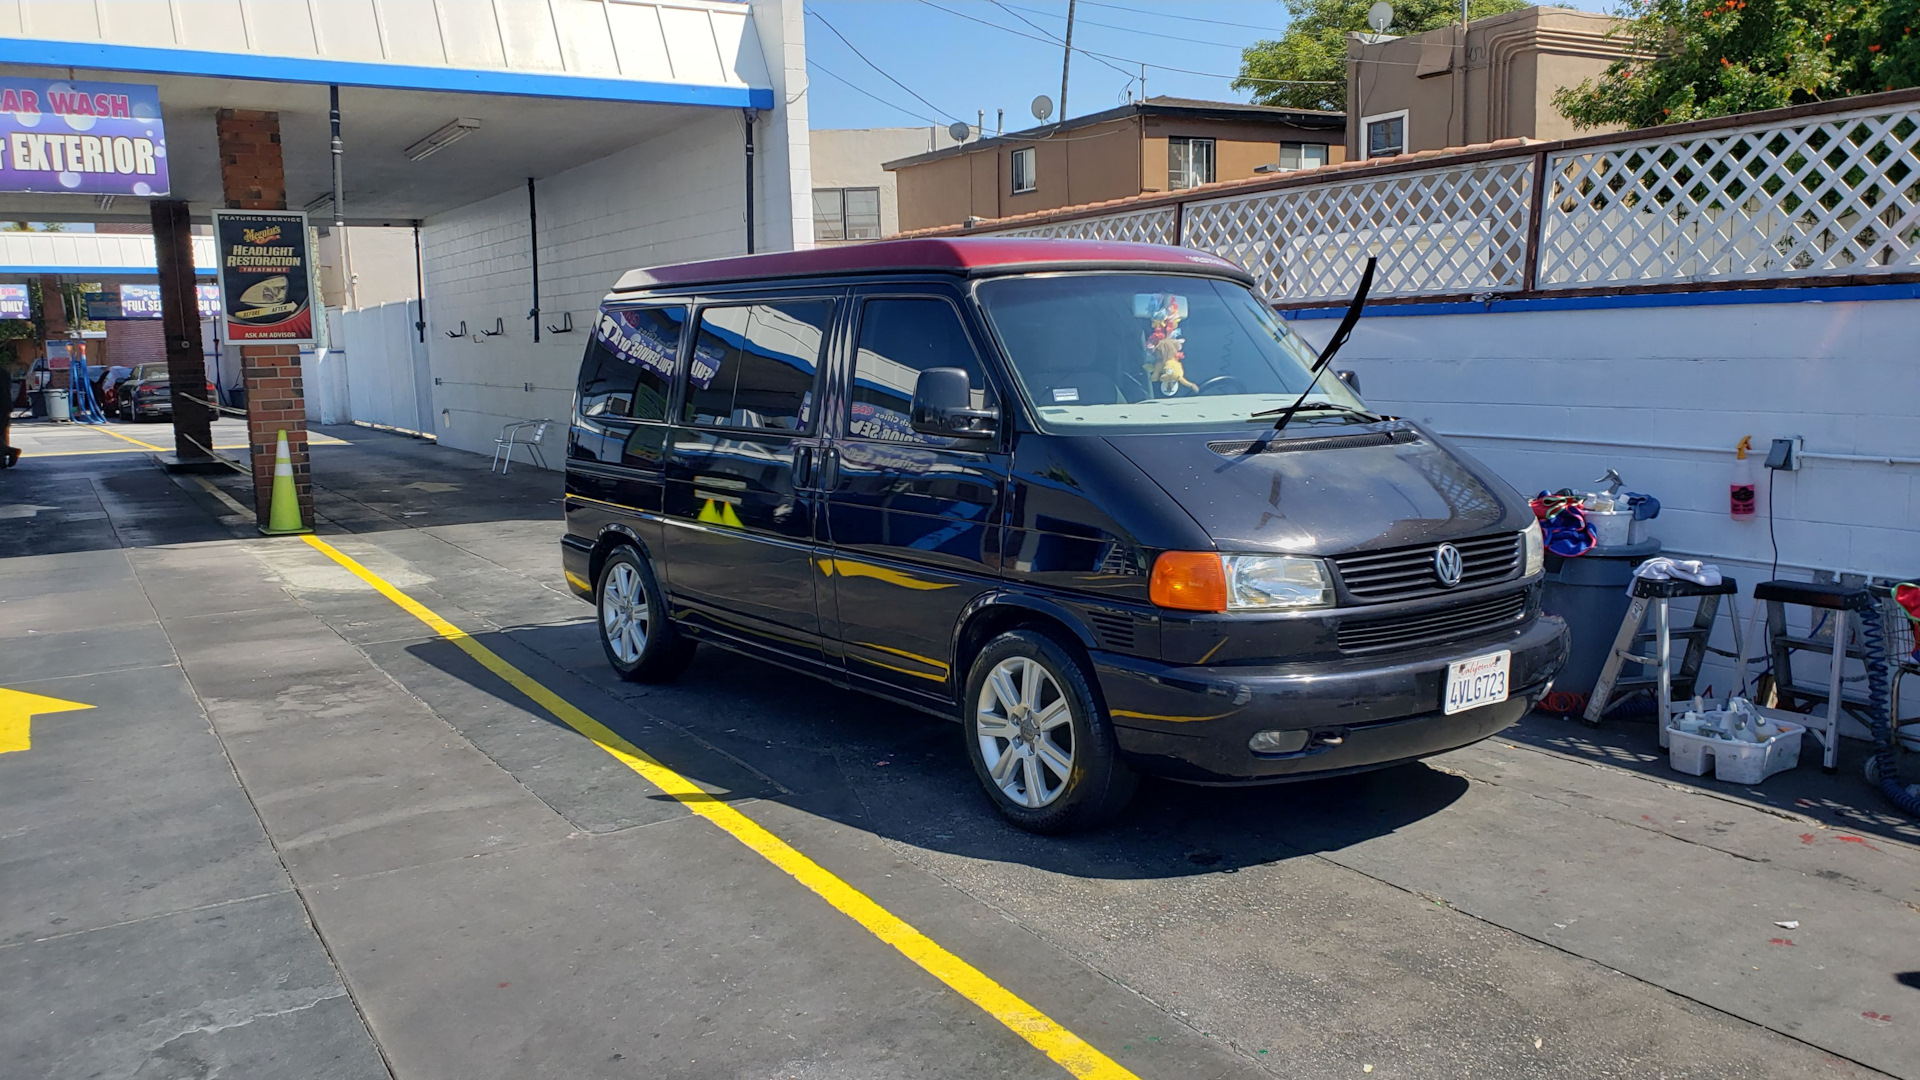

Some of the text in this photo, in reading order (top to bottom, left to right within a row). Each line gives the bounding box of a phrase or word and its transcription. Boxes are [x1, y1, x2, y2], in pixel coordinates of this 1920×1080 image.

[0, 89, 130, 119] AR WASH
[10, 132, 157, 175] EXTERIOR
[232, 245, 295, 256] HEADLIGHT
[226, 255, 301, 267] RESTORATION
[0, 300, 23, 312] ONLY
[127, 300, 147, 312] FULL
[243, 305, 288, 318] BEFORE AFTER
[1450, 670, 1505, 706] 4VLG723
